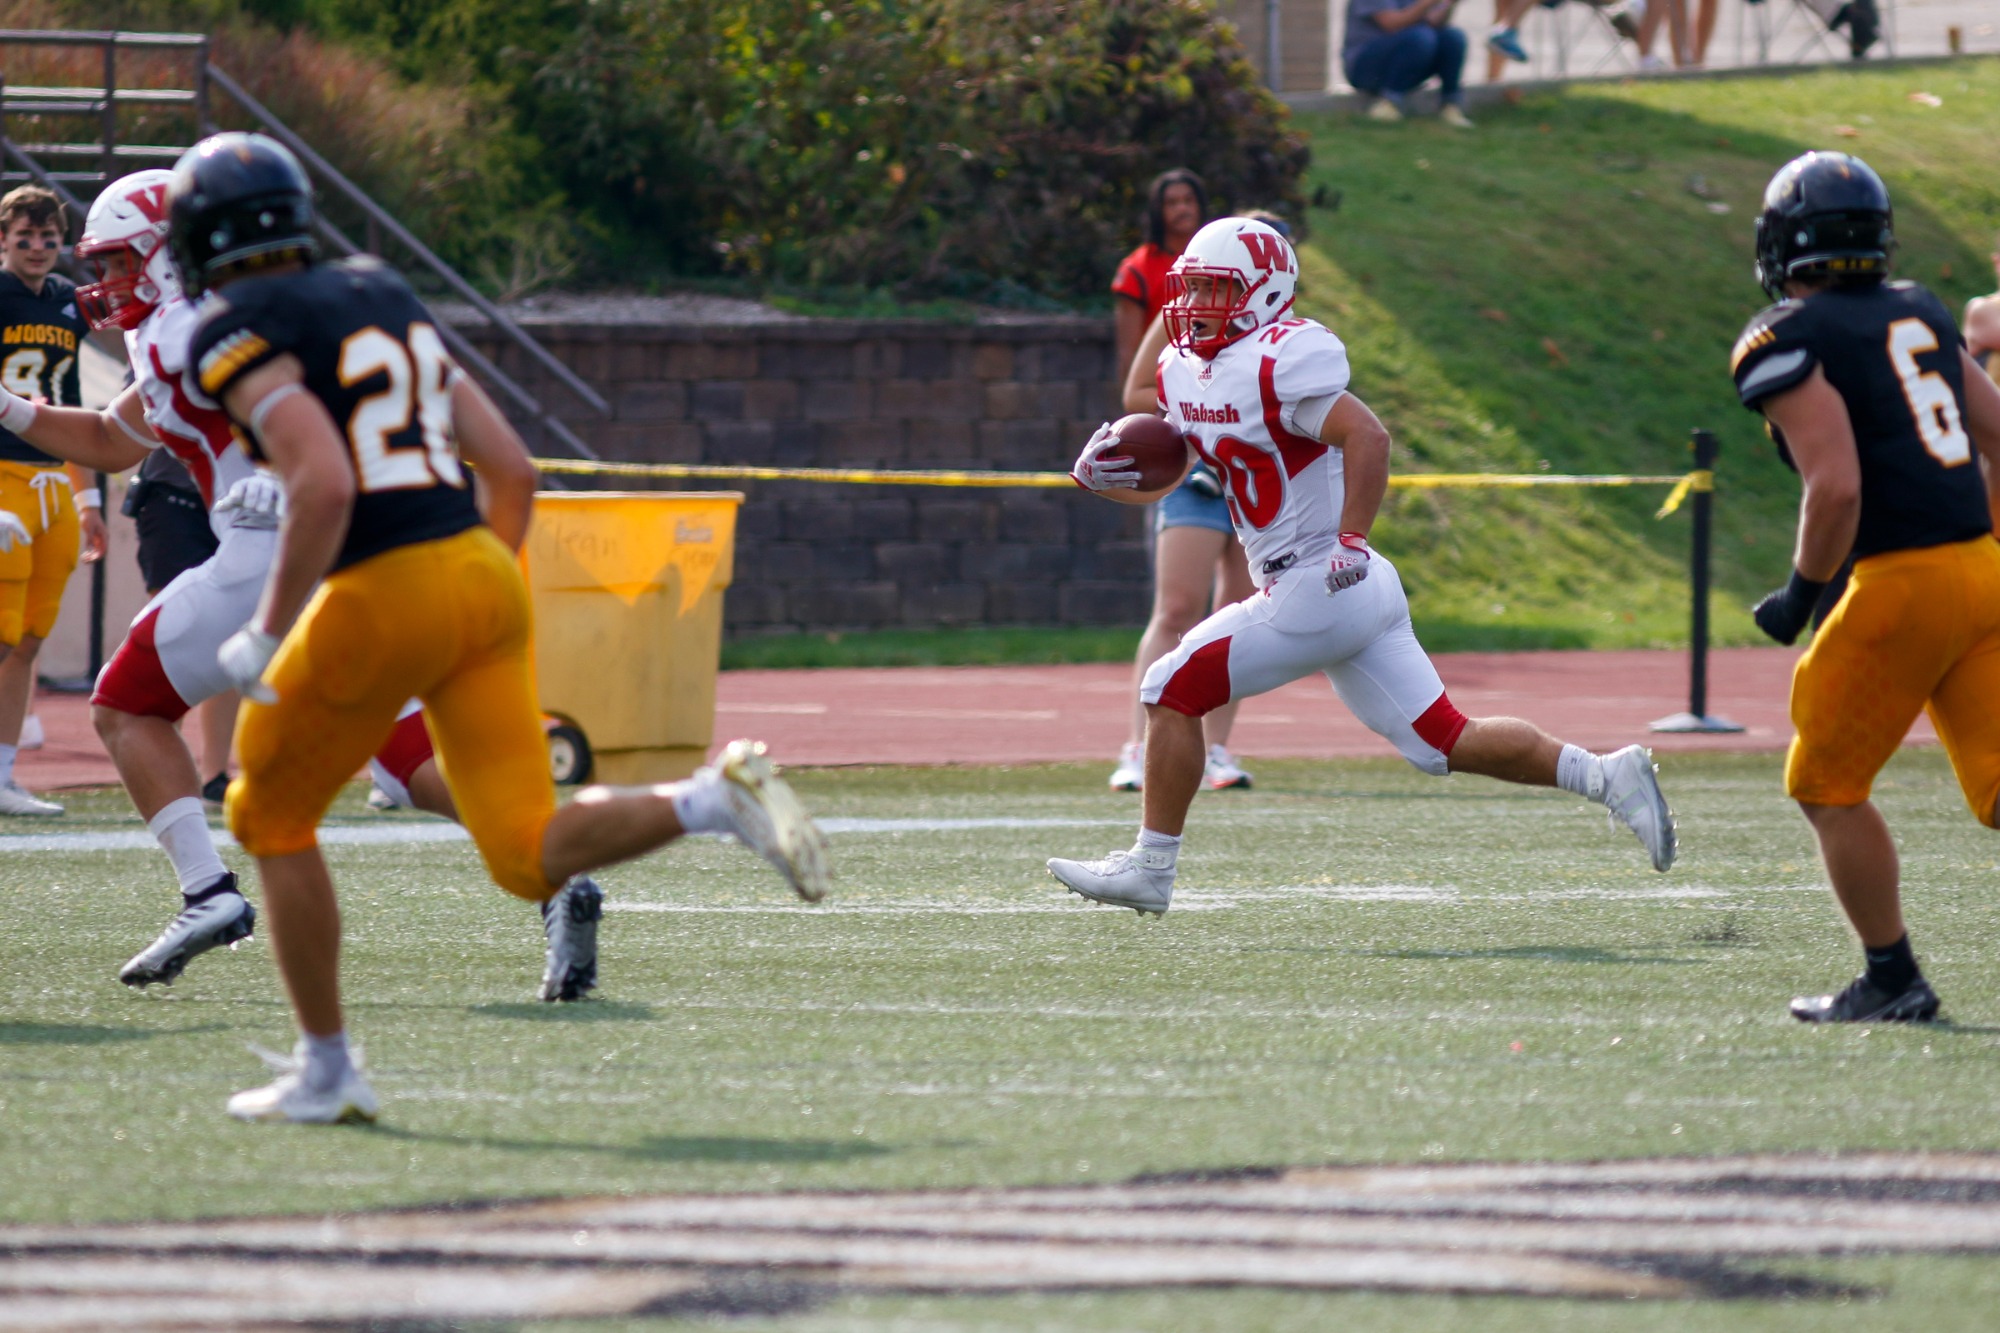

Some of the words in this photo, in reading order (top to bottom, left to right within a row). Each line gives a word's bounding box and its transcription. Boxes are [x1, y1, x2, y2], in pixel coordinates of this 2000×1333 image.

[1237, 232, 1289, 273] W
[3, 323, 77, 353] WOOSTE
[1887, 316, 1972, 469] 6
[1179, 401, 1242, 425] Wabash
